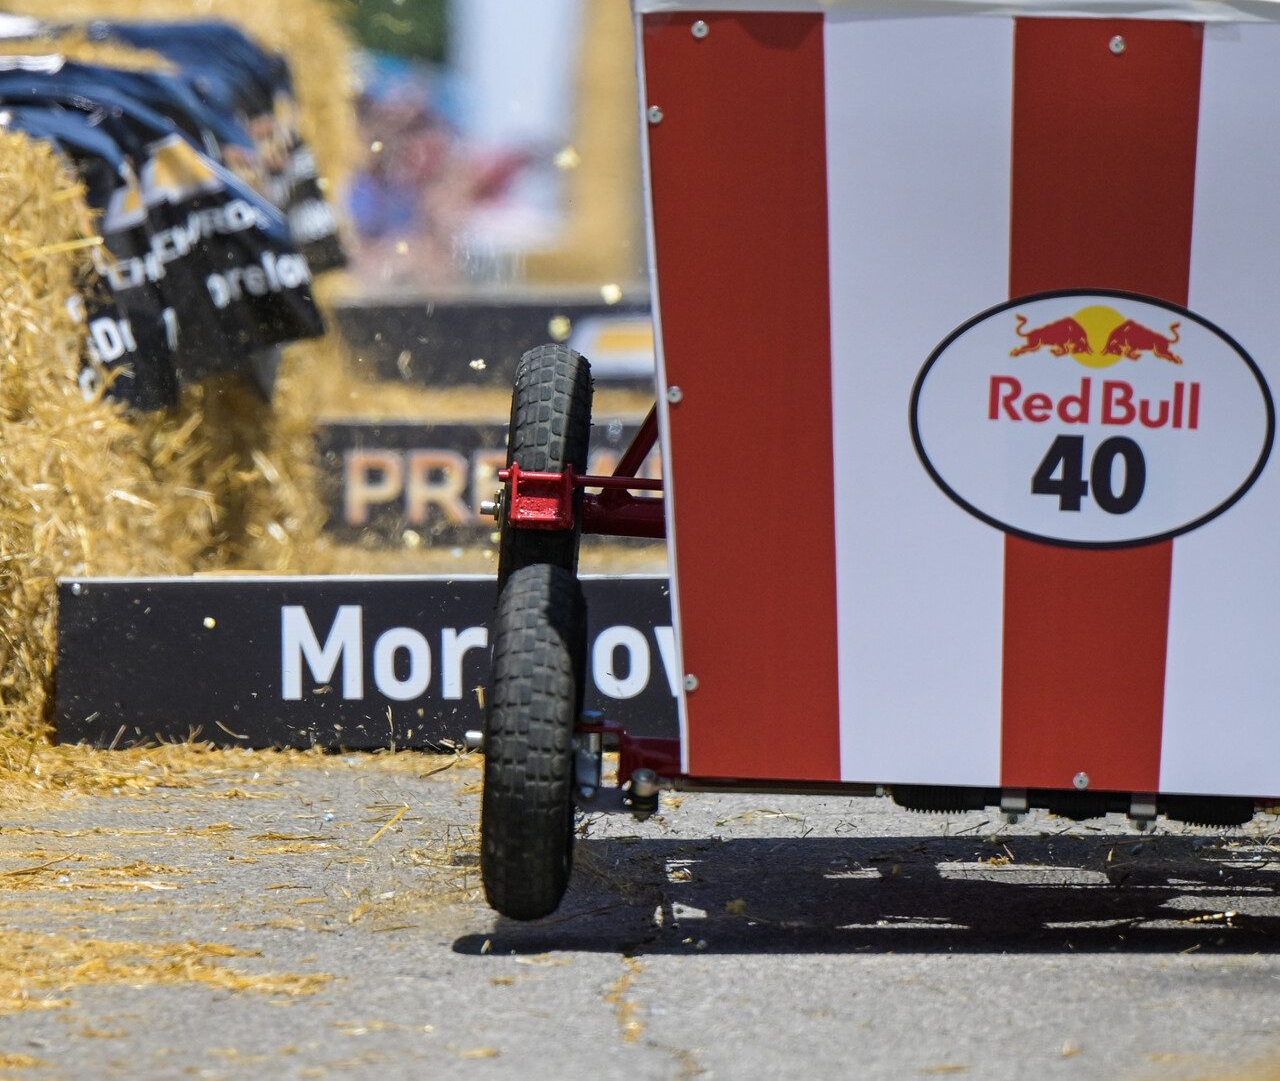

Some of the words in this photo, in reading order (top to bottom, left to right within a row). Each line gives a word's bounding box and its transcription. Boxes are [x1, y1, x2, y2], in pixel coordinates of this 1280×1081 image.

[988, 375, 1091, 424] Red
[1100, 379, 1201, 430] Bull
[1031, 434, 1146, 515] 40
